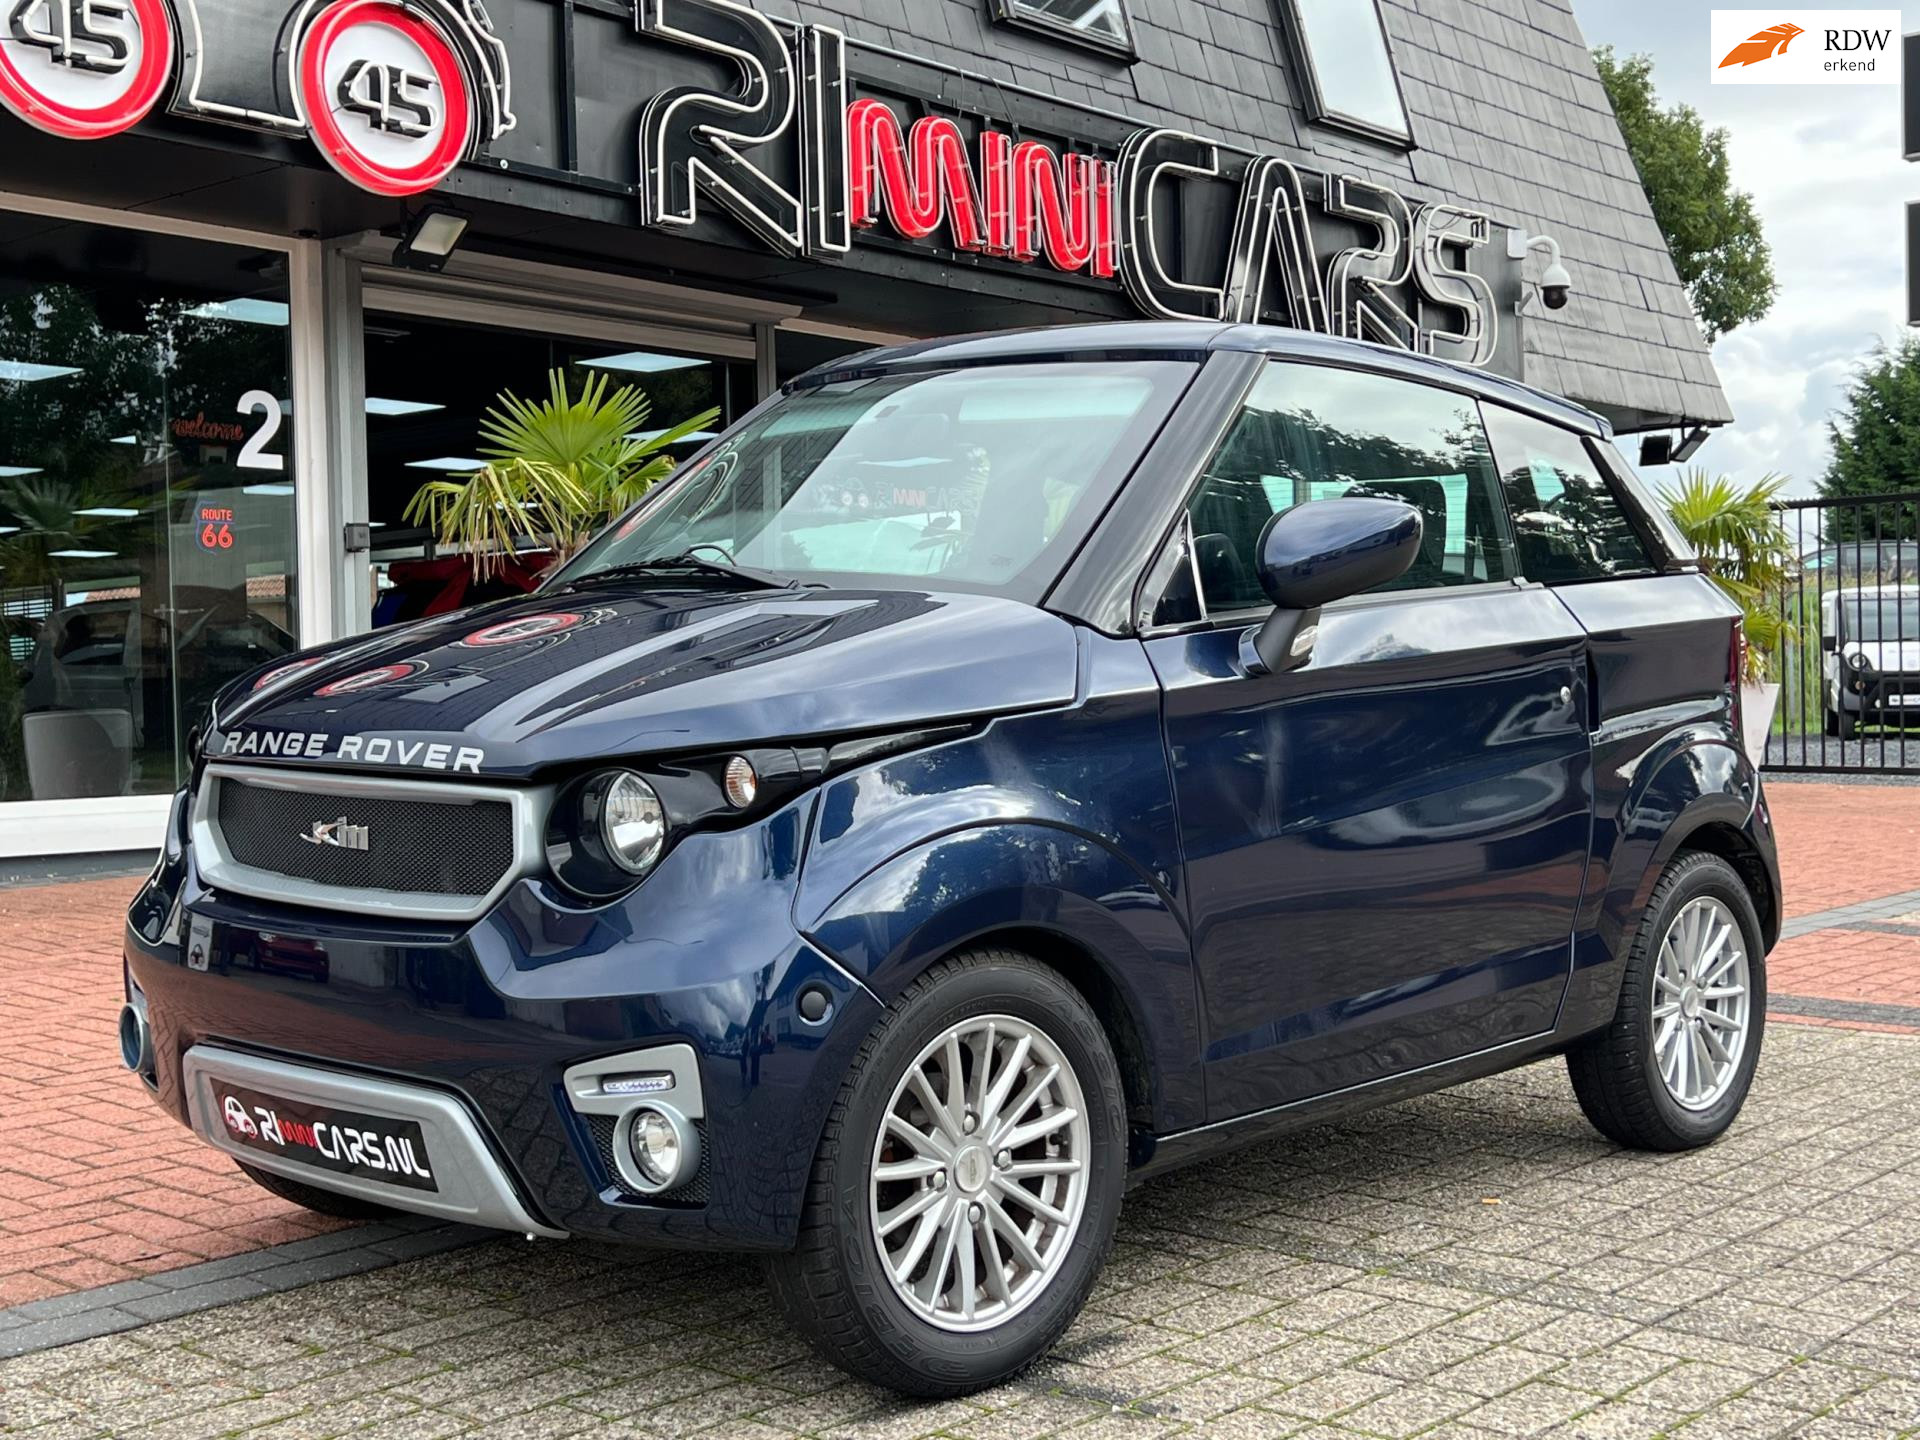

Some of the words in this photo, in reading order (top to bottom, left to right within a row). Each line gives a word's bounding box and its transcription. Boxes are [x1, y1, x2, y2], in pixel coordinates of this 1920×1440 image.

[8, 0, 134, 75] 45
[336, 59, 440, 139] 45
[172, 411, 245, 441] welcome
[236, 389, 284, 470] 2
[202, 508, 233, 521] ROUTE
[202, 523, 233, 549] 66
[222, 731, 329, 757] RANGE
[336, 735, 485, 774] ROVER
